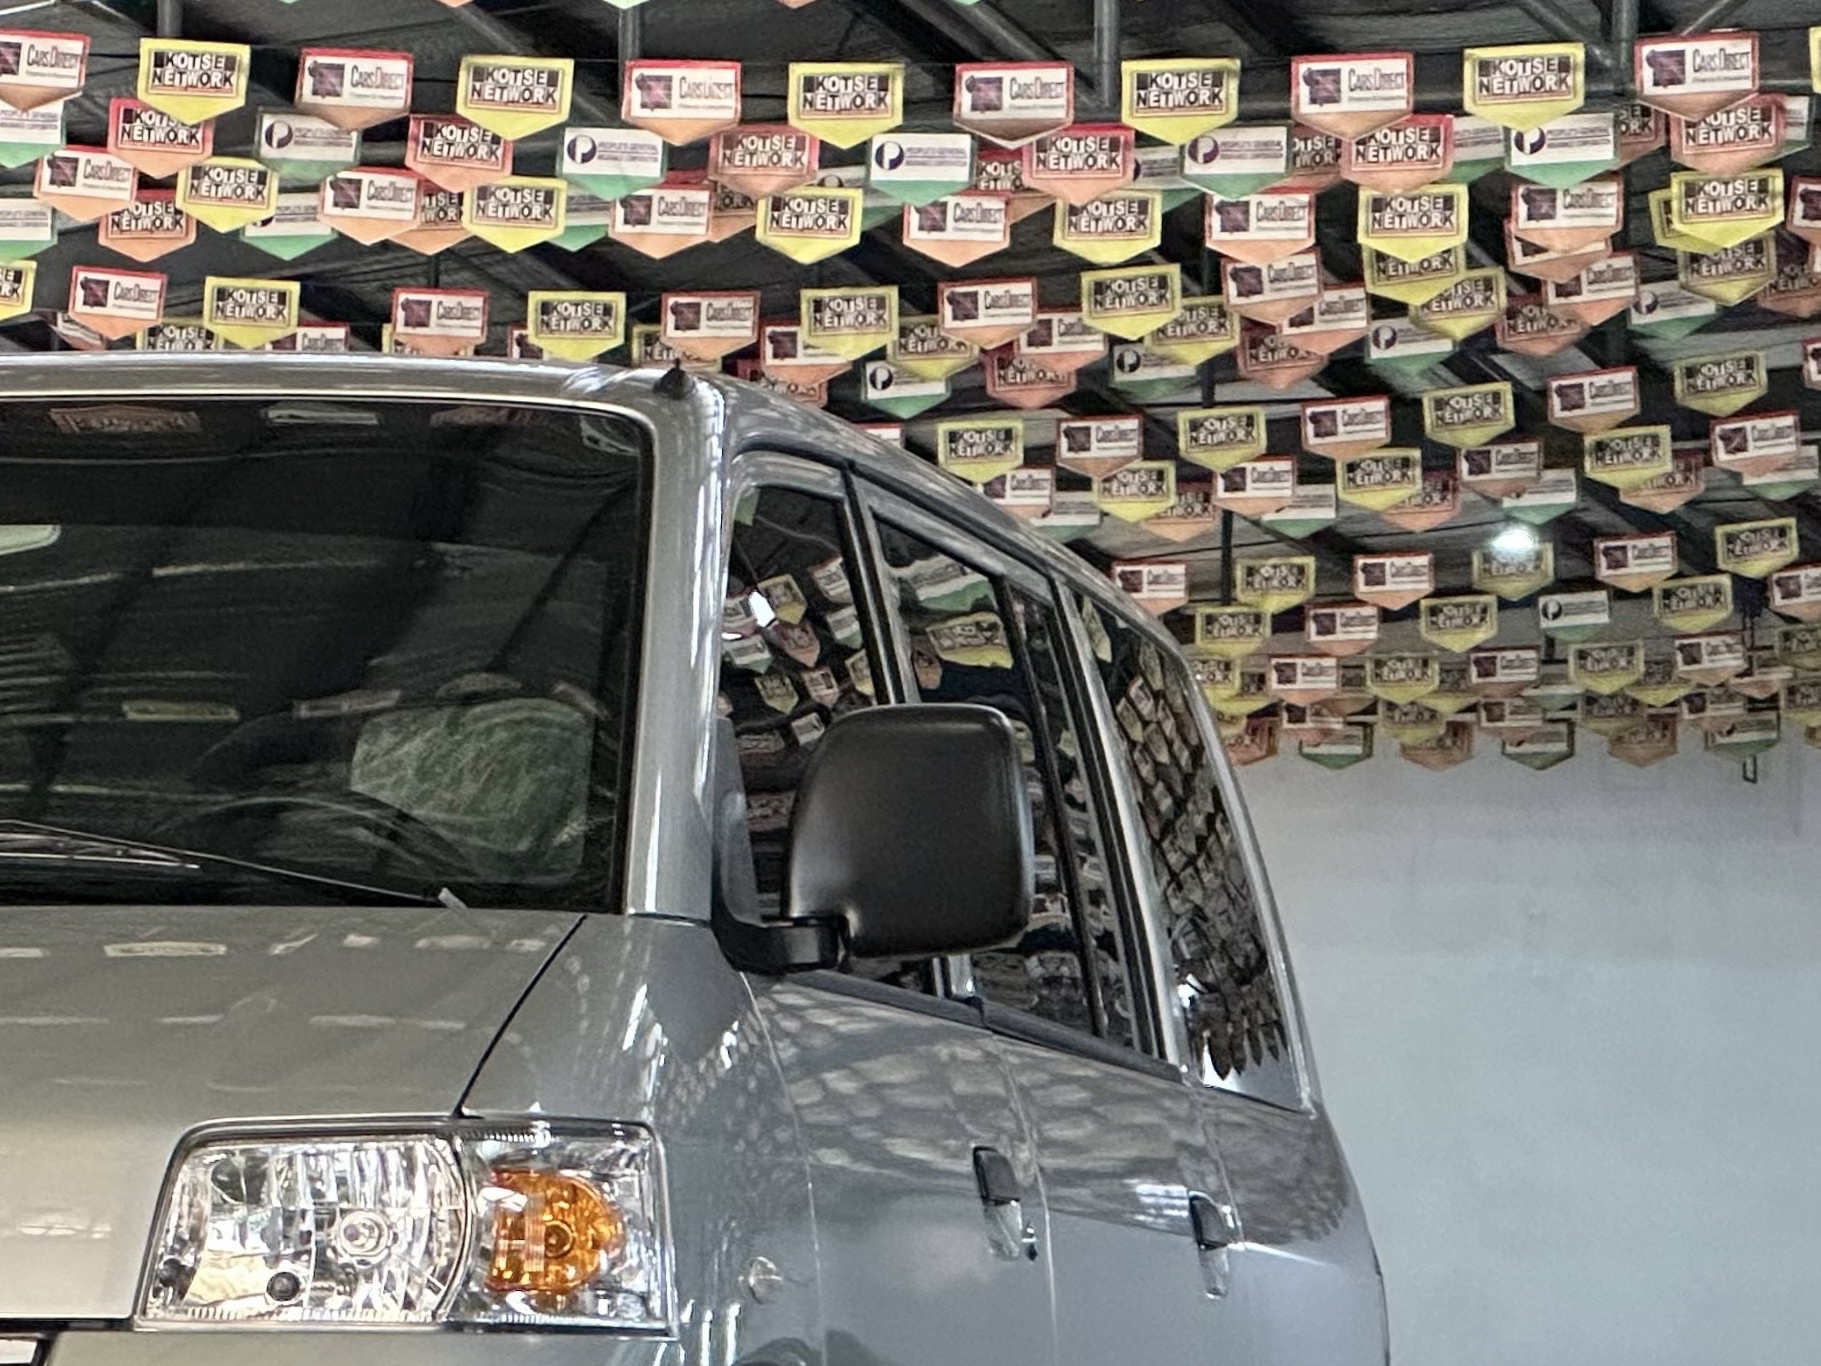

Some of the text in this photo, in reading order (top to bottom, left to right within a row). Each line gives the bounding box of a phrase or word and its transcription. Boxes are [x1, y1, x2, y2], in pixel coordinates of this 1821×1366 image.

[166, 52, 224, 69] KOTSE
[1494, 57, 1557, 76] KOTSE
[153, 68, 235, 88] NETWORK
[487, 69, 547, 86] KOTSE
[816, 76, 876, 92] KOTSE
[1149, 73, 1212, 89] KOTSE
[1479, 75, 1570, 95] NETWORK
[472, 86, 556, 102] NETWORK
[804, 92, 888, 109] NETWORK
[1137, 88, 1223, 106] NETWORK
[1702, 107, 1760, 126] KOTSE
[122, 124, 200, 144] NETWORK
[435, 122, 490, 141] KOTSE
[1367, 127, 1430, 145] KOTSE
[1686, 123, 1772, 144] NETWORK
[422, 139, 499, 161] NETWORK
[737, 134, 794, 151] KOTSE
[1049, 137, 1109, 152] KOTSE
[722, 149, 805, 168] NETWORK
[1037, 153, 1120, 170] NETWORK
[1355, 144, 1440, 164] NETWORK
[204, 167, 257, 184] KOTSE
[190, 181, 265, 199] NETWORK
[490, 187, 543, 202] KOTSE
[1698, 181, 1758, 196] KOTSE
[477, 202, 551, 219] NETWORK
[783, 198, 838, 214] KOTSE
[1080, 200, 1139, 215] KOTSE
[1385, 195, 1442, 211] KOTSE
[1686, 196, 1768, 214] NETWORK
[111, 213, 183, 230] NETWORK
[771, 213, 847, 230] NETWORK
[1068, 215, 1147, 232] NETWORK
[1372, 211, 1454, 229] NETWORK
[1691, 259, 1765, 277] NETWORK
[1105, 278, 1158, 294] KOTSE
[227, 288, 278, 303] KOTSE
[827, 294, 877, 311] KOTSE
[1094, 292, 1170, 309] NETWORK
[216, 301, 287, 320] NETWORK
[552, 302, 603, 316] KOTSE
[541, 315, 611, 331] NETWORK
[814, 310, 888, 327] NETWORK
